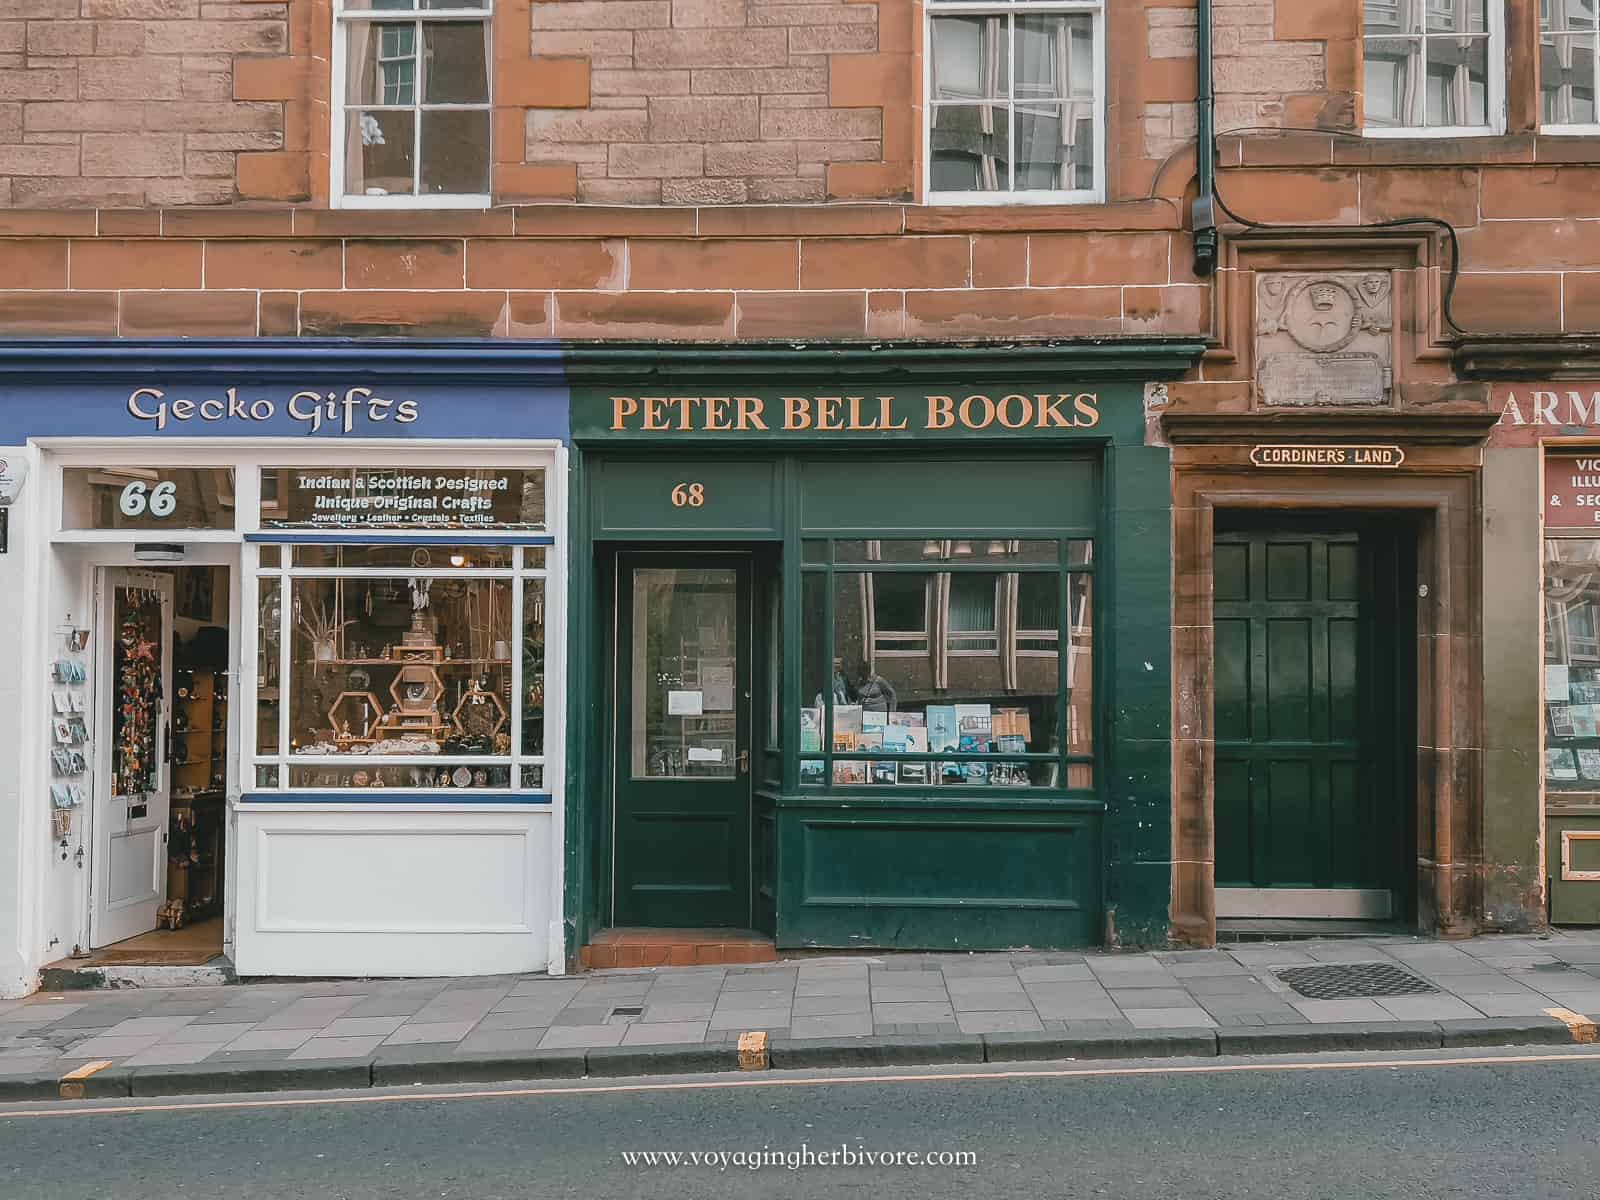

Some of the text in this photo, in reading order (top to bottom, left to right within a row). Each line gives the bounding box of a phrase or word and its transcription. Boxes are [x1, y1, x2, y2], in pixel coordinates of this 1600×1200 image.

[127, 386, 419, 434] Gecko Gifts
[608, 392, 1101, 431] PETER BELL BOOKS
[1495, 391, 1600, 426] ARM
[1263, 449, 1392, 463] CORDINER'S LAND
[299, 475, 509, 491] Indian & Scottish Designed
[671, 483, 705, 507] 68
[119, 480, 177, 517] 66
[315, 495, 493, 512] Unique Original Crafts
[1550, 494, 1562, 506] &
